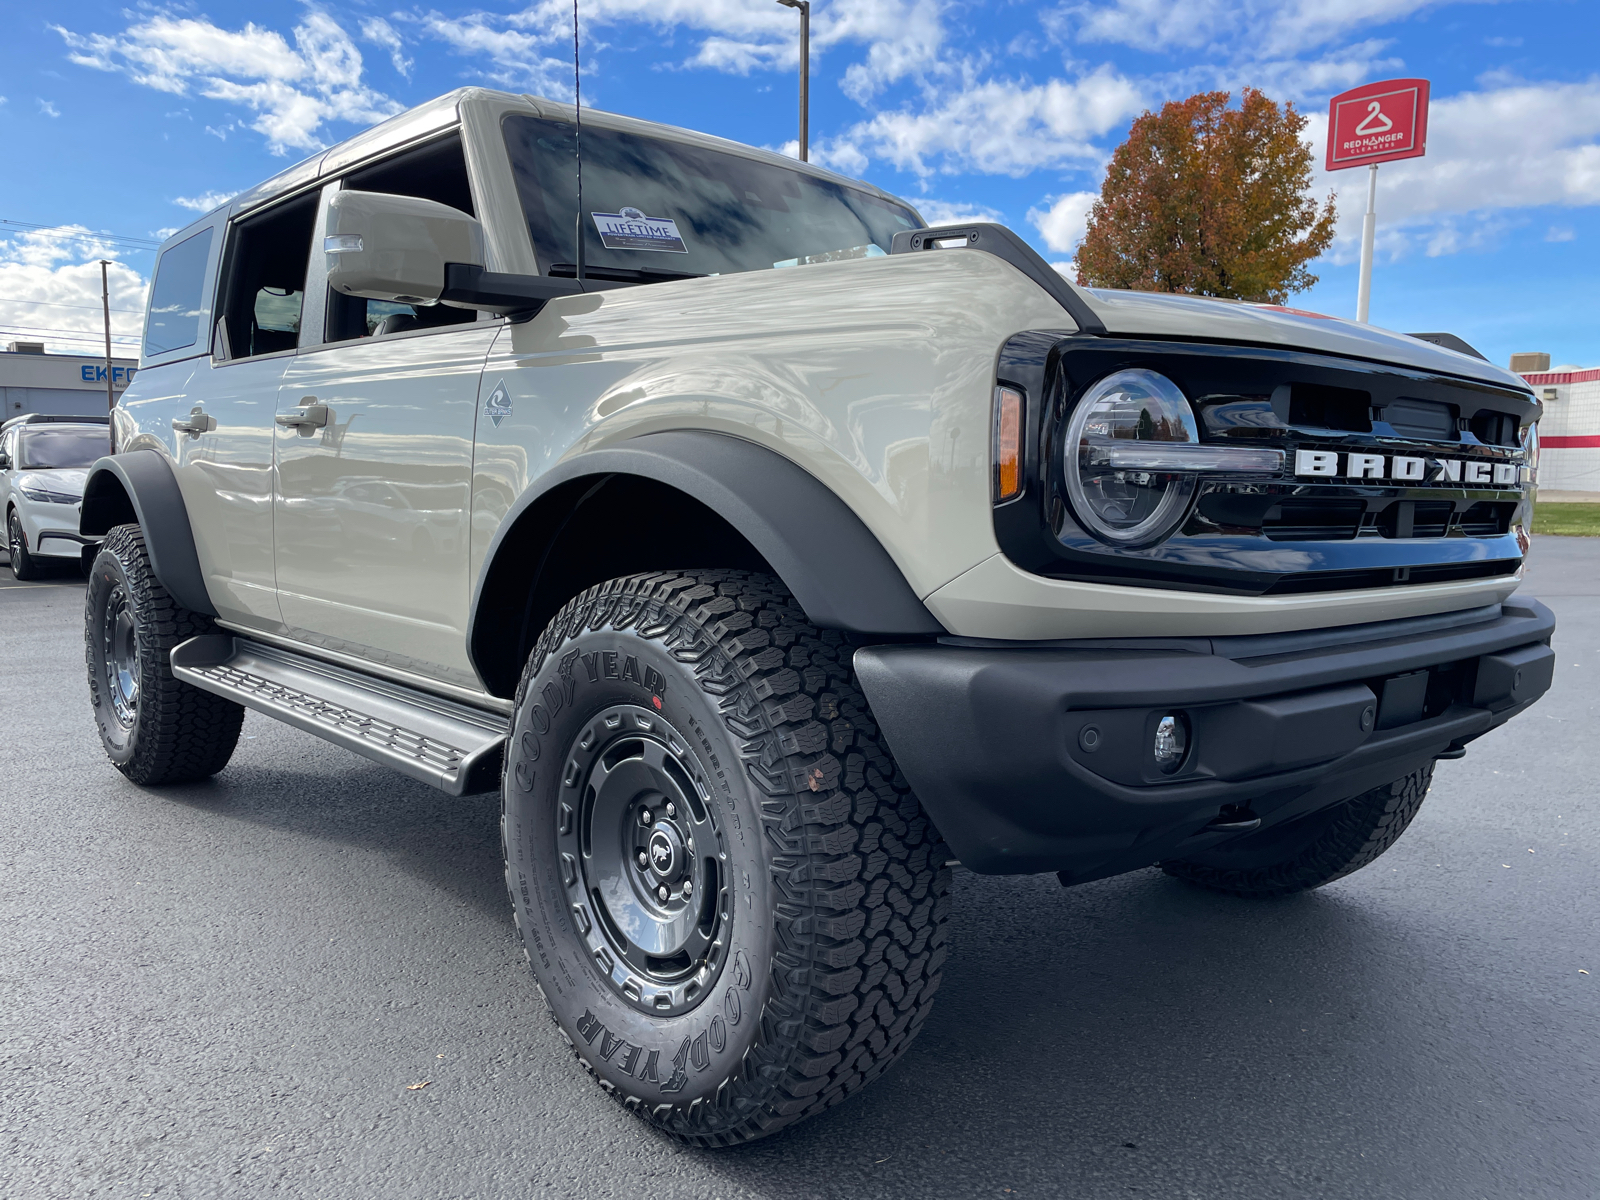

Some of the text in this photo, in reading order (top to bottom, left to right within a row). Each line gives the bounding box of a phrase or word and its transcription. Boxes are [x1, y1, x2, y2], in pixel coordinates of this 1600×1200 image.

[1343, 132, 1404, 149] RED HANGER
[1350, 143, 1395, 154] CLEANERS
[606, 222, 672, 237] LIFETIME
[1294, 449, 1516, 485] BRONCO
